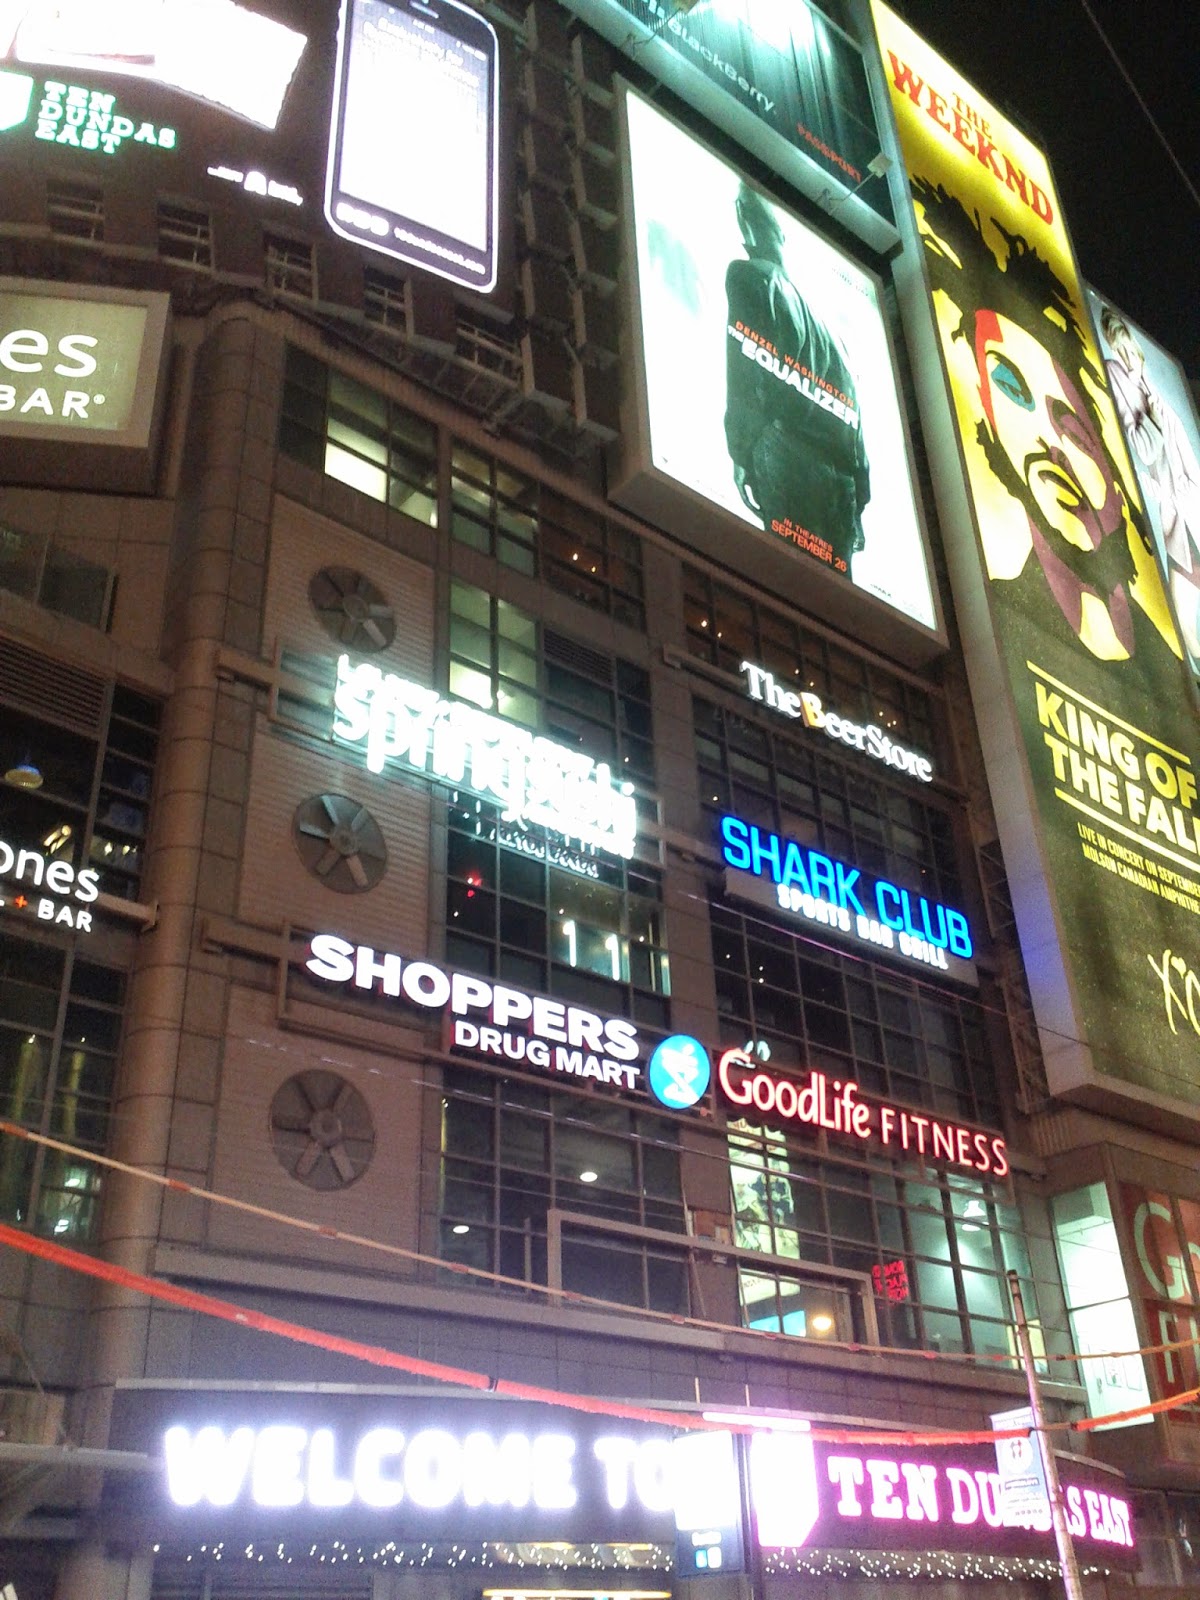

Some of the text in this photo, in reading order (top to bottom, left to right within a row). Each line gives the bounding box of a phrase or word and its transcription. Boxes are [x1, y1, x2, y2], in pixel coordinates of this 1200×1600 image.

[34, 118, 121, 154] EAST
[38, 98, 176, 149] DUNDAS
[43, 80, 117, 114] TEN
[887, 49, 1054, 226] WEEKND
[952, 91, 993, 140] THE
[735, 320, 854, 408] DENZEL WASHINGTON
[741, 337, 859, 430] EQUALIZER
[771, 519, 847, 573] SEPTEMBER 26
[783, 517, 833, 553] IN THEATRES
[739, 660, 932, 783] The Beer Store
[1035, 681, 1198, 810] KING OF
[1043, 731, 1124, 816] THE
[720, 816, 973, 959] SHARK CLUB
[1078, 821, 1098, 846] LIVE
[1096, 832, 1108, 852] IN
[1106, 838, 1145, 871] CONCERT
[1144, 858, 1159, 878] ON
[1081, 842, 1118, 874] MOLSON
[1116, 861, 1161, 896] CANADIAN
[37, 898, 93, 933] BAR
[776, 883, 949, 970] SPORTS BAR GRILL
[305, 934, 641, 1061] SHOPPERS
[454, 1020, 642, 1091] DRUG MART
[718, 1048, 1010, 1177] GoodLife FITNESS
[163, 1424, 580, 1510] WELCOME
[827, 1455, 939, 1523] TEN
[1083, 1489, 1135, 1548] EAST
